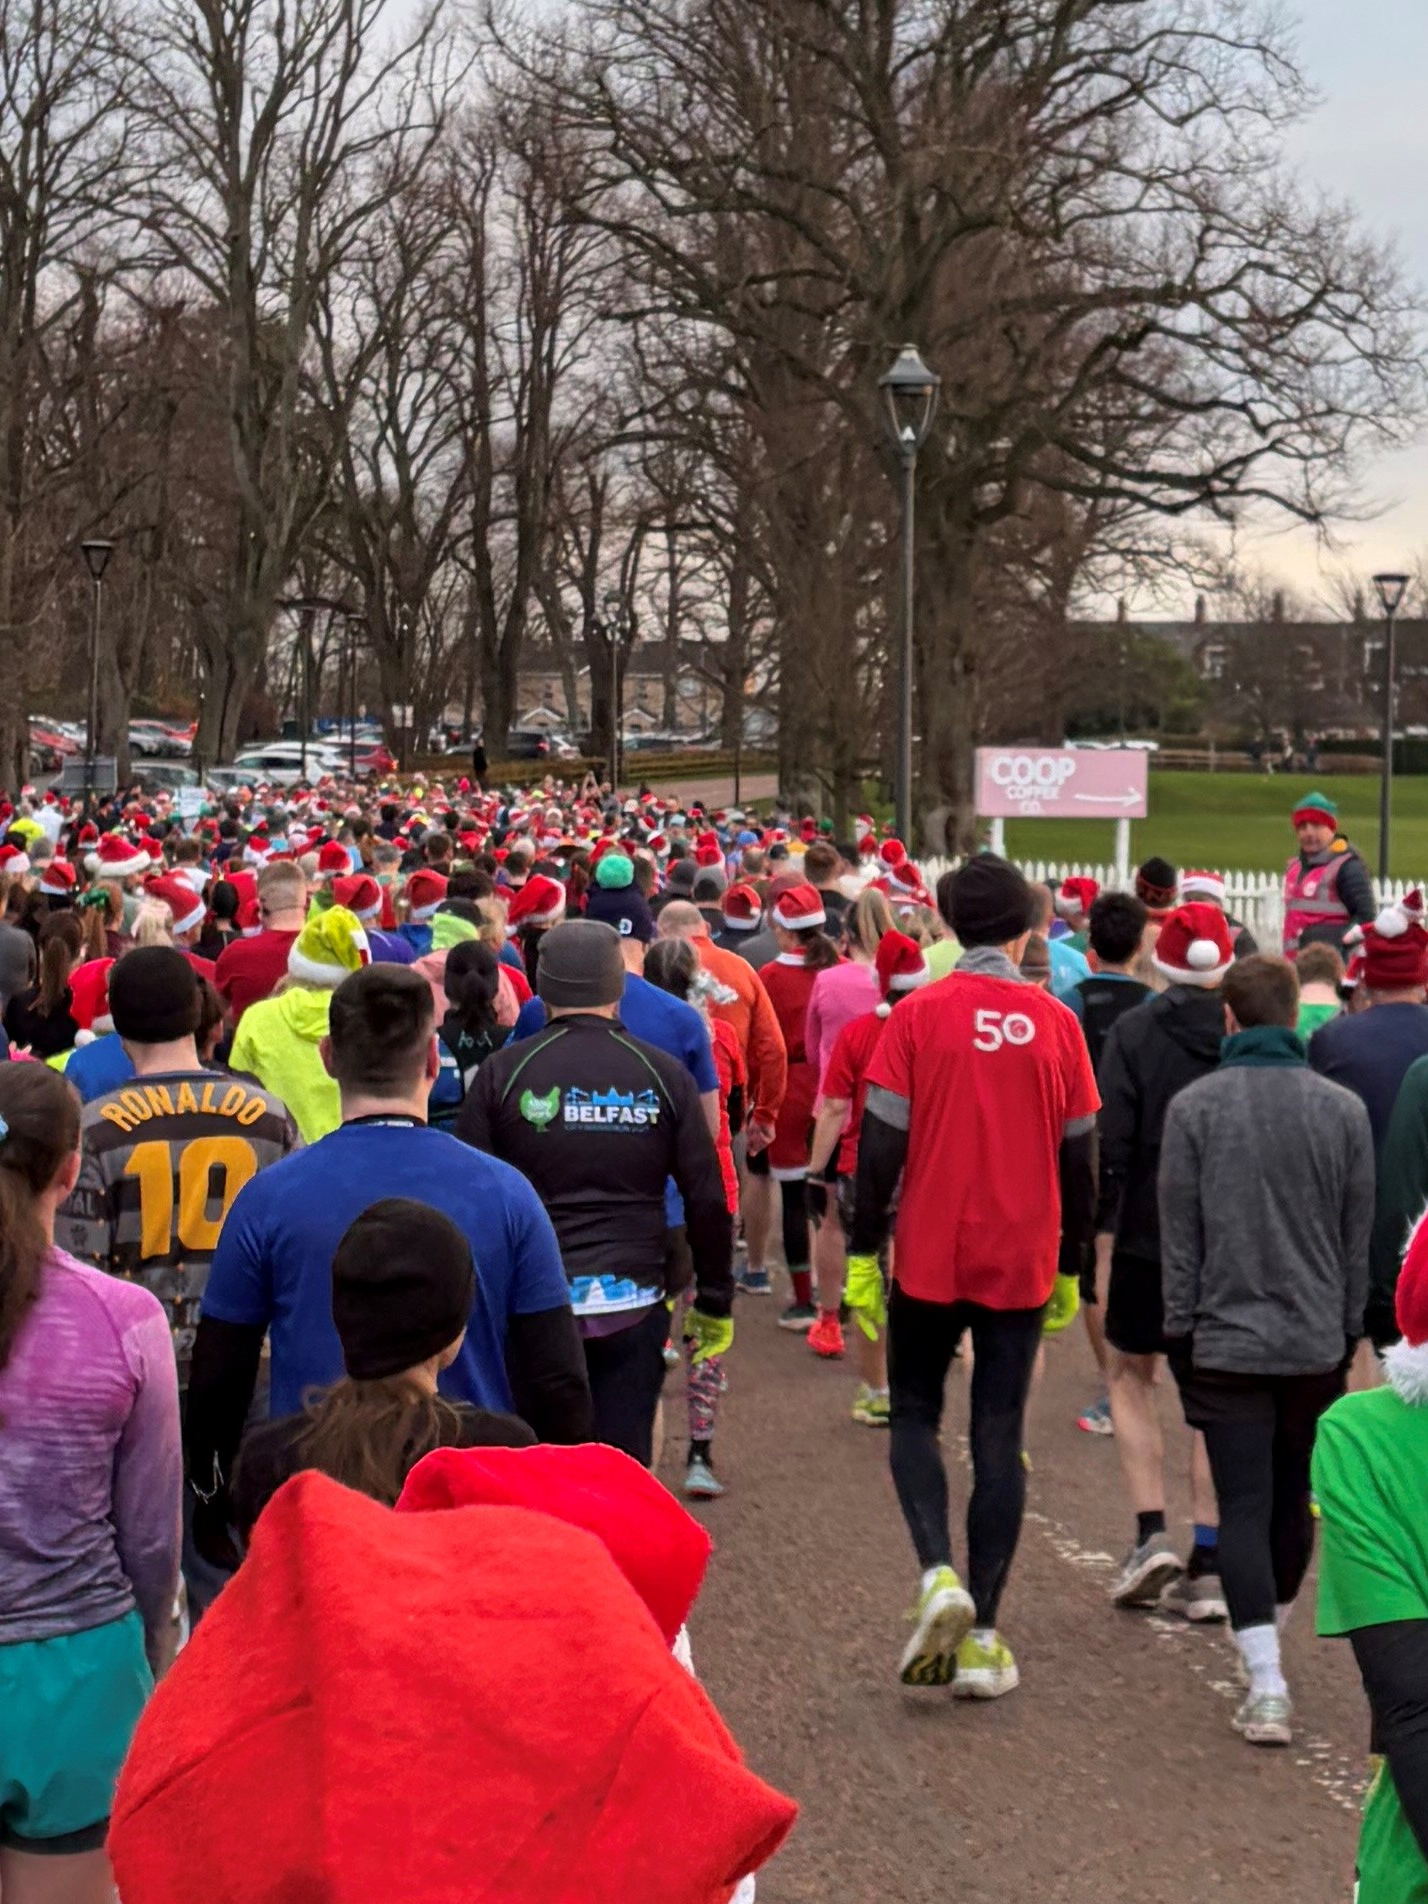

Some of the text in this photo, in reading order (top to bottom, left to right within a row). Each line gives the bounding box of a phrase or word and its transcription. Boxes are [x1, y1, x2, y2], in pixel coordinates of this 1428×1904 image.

[991, 756, 1076, 786] COOP
[973, 1009, 1036, 1052] 50
[100, 1082, 267, 1132] RONALDO
[563, 1106, 660, 1124] BELFAST
[124, 1136, 259, 1260] 10
